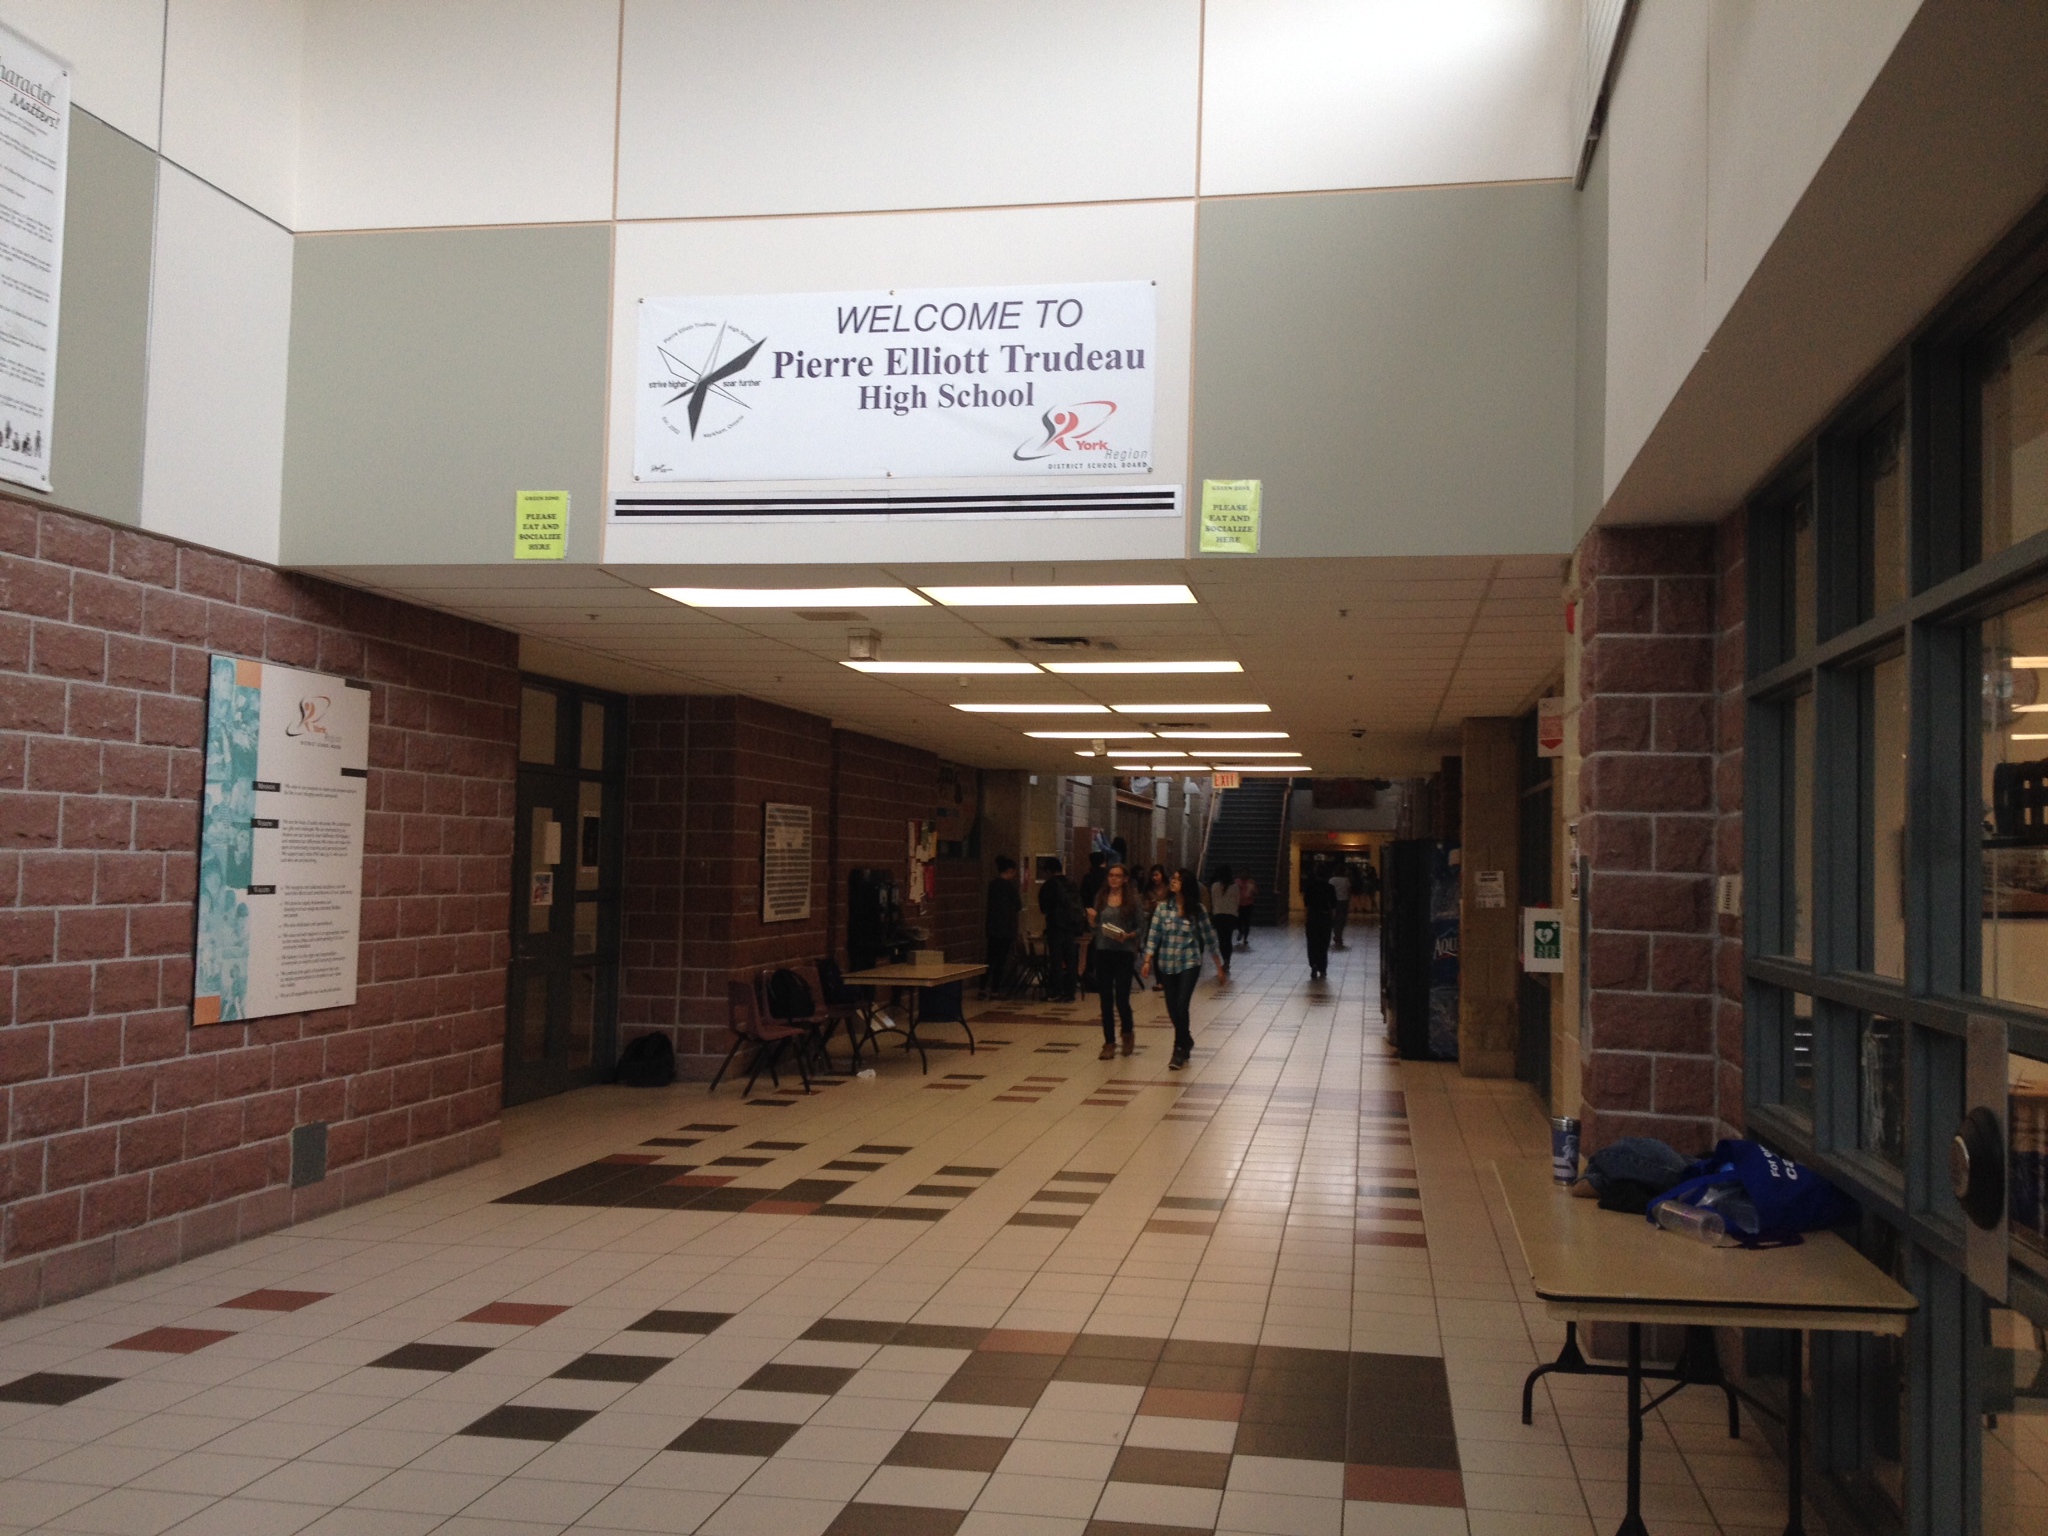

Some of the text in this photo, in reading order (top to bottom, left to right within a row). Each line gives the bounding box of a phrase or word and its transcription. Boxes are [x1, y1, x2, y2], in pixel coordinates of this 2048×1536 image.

[9, 92, 61, 130] Matters!
[837, 298, 1083, 334] WELCOME TO
[772, 342, 1146, 379] Pierre Elliott Trudeau
[648, 379, 688, 389] strive higher
[738, 379, 762, 387] further
[858, 381, 1035, 416] High School
[1076, 439, 1110, 451] York
[1104, 448, 1148, 462] Region
[1214, 773, 1236, 787] EXIT
